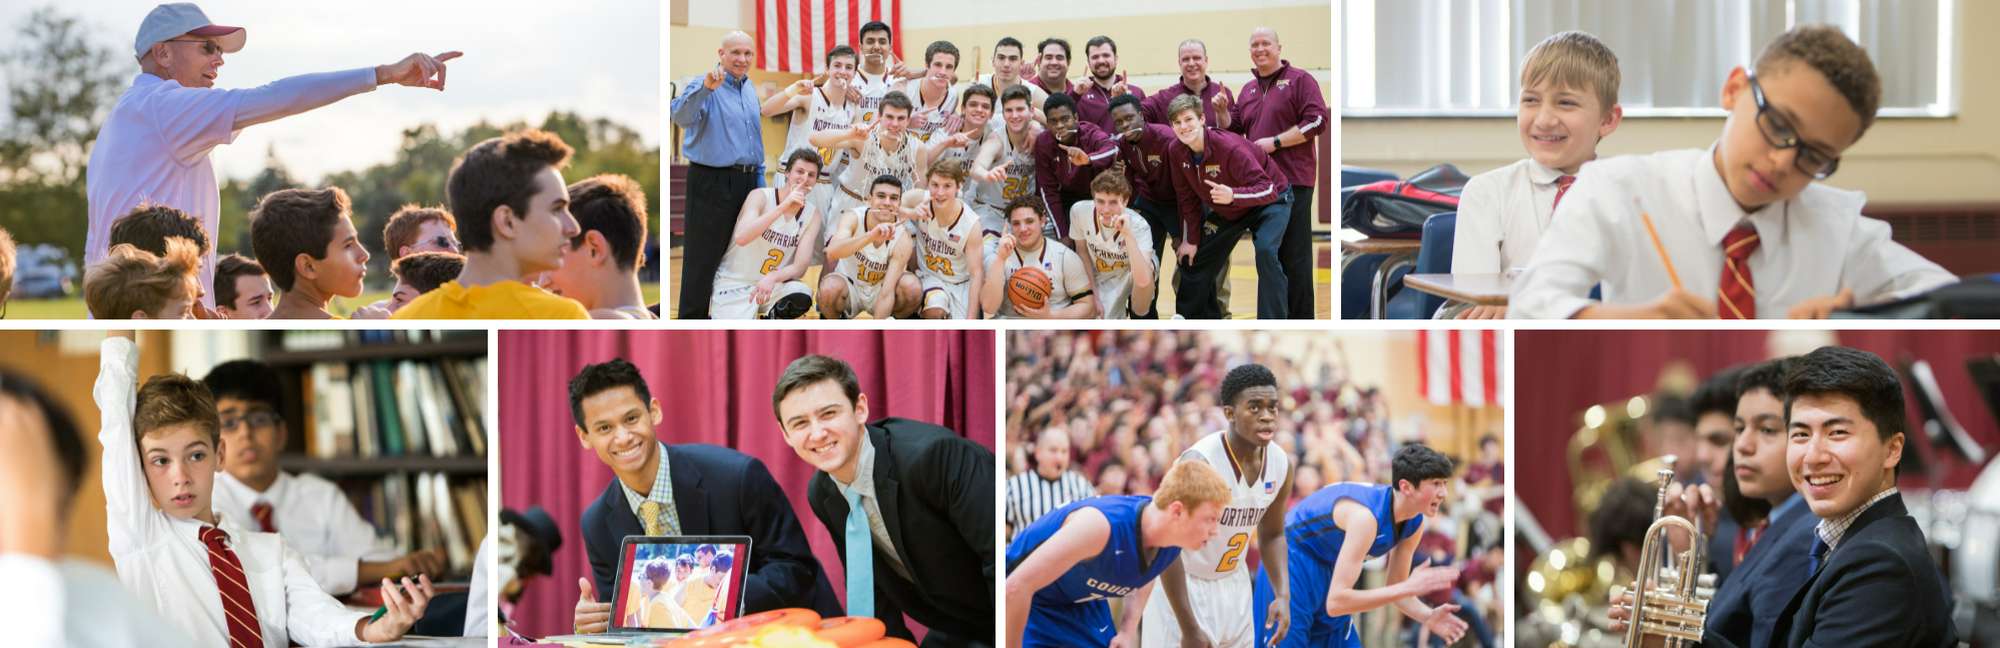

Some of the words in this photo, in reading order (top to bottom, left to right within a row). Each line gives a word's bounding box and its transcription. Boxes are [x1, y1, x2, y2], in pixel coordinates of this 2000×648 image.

[760, 248, 785, 275] 2
[1218, 507, 1267, 527] ORTHRI
[1216, 532, 1249, 572] 2
[1087, 578, 1132, 596] COUG
